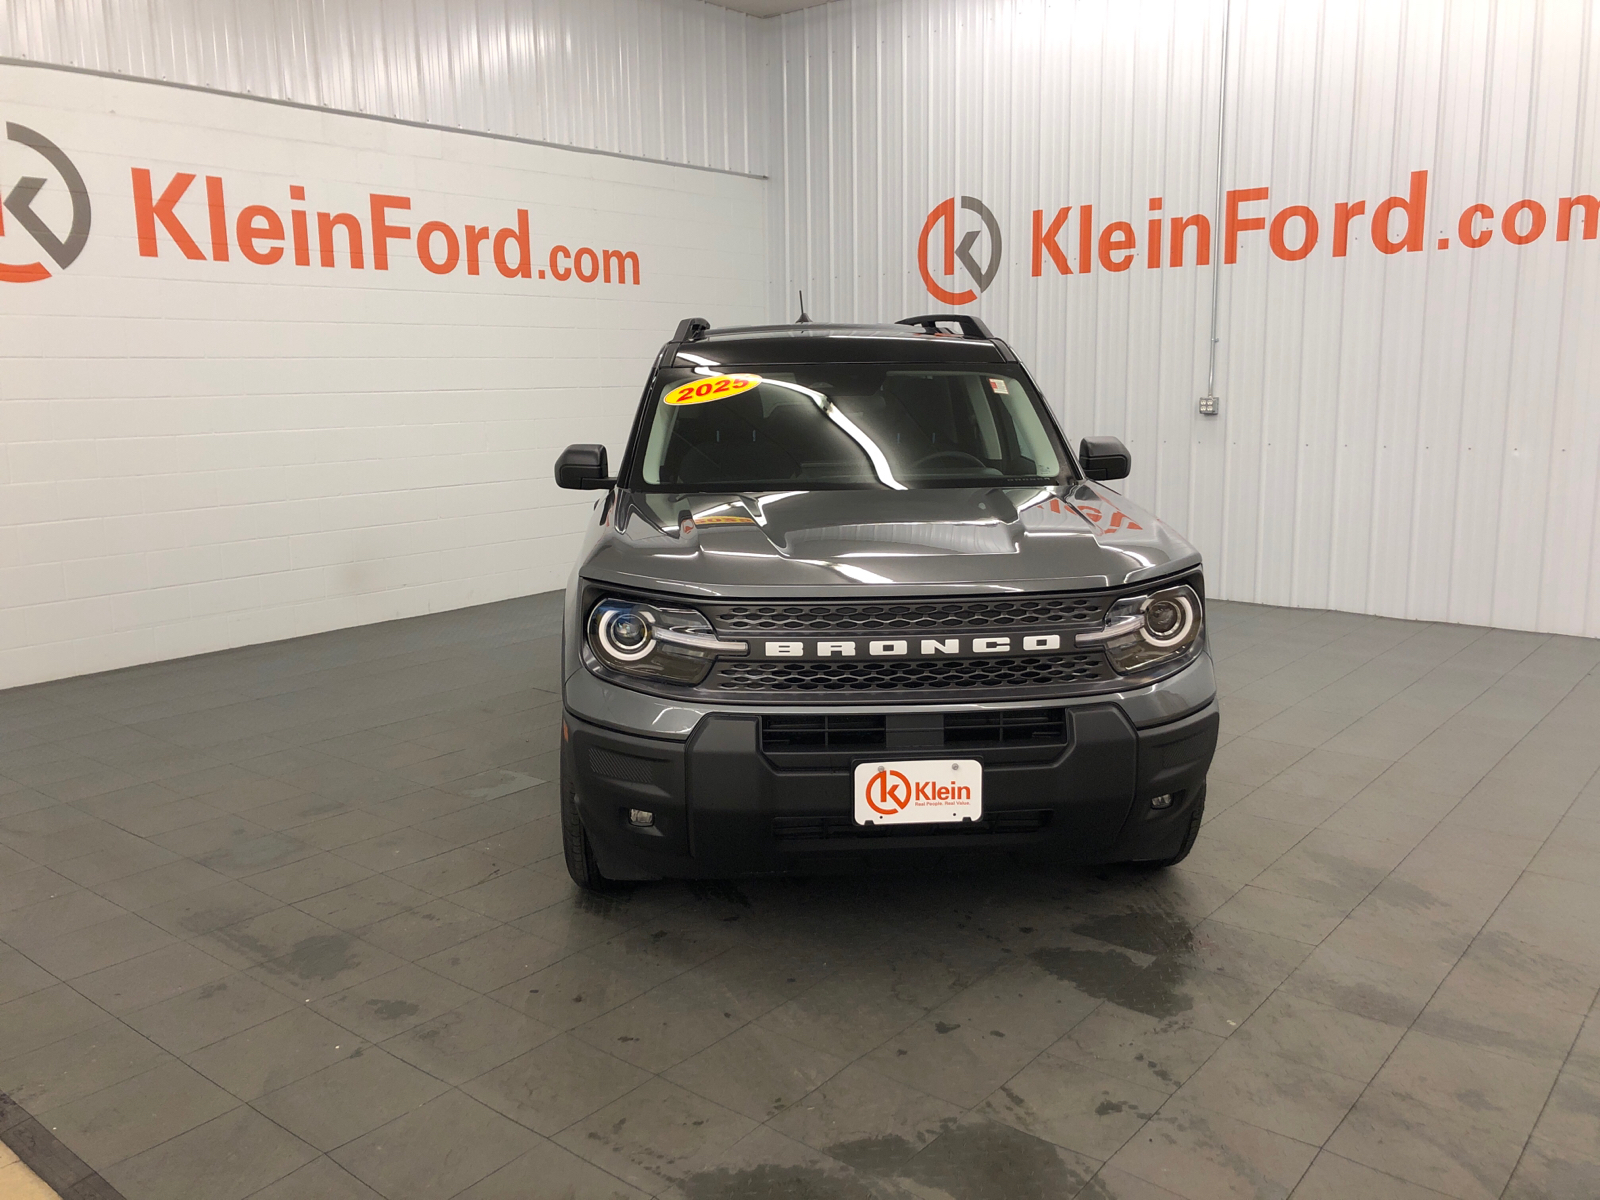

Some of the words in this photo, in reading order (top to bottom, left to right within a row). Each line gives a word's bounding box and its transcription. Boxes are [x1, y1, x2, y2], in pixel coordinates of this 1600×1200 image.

[131, 168, 640, 285] KleinFord.com
[1031, 170, 1600, 277] KleinFord.com
[676, 379, 749, 402] 2025
[765, 635, 1060, 657] BRONCO
[915, 781, 971, 801] Klein
